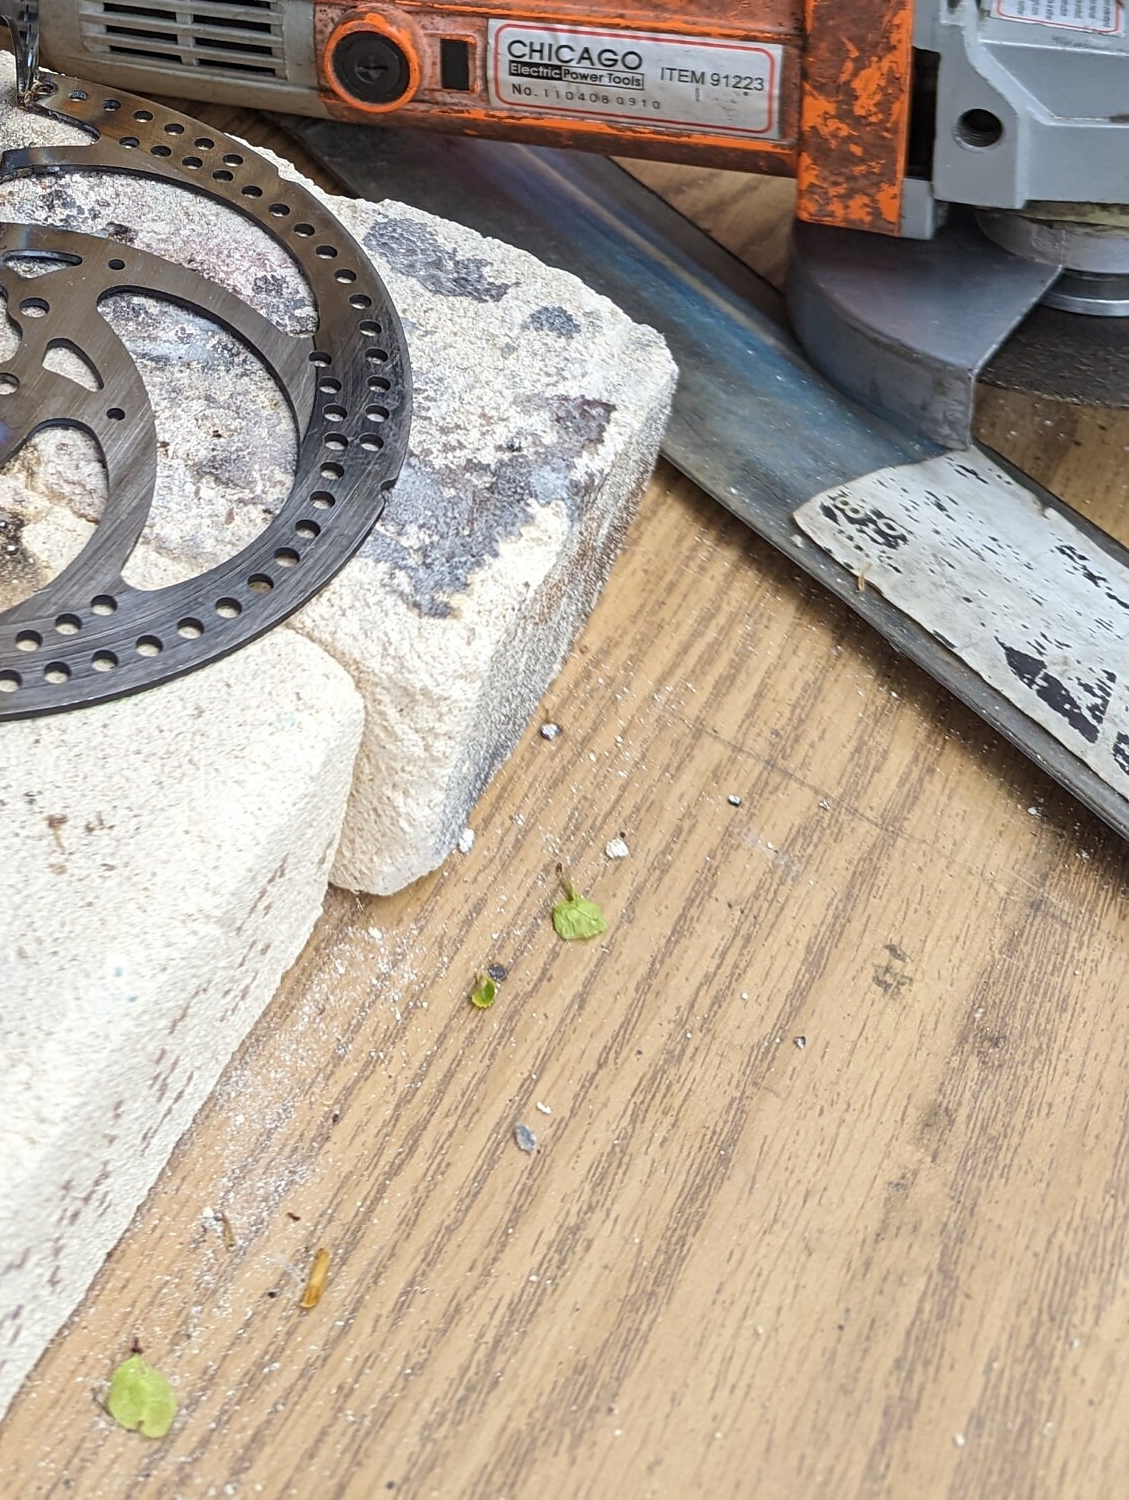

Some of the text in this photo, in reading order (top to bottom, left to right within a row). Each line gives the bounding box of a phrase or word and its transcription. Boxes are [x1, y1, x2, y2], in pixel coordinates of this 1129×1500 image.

[507, 39, 643, 70] CHICAGO
[510, 63, 642, 87] Electric Power Tools
[660, 66, 764, 91] ITEM 91223
[511, 83, 538, 97] No.
